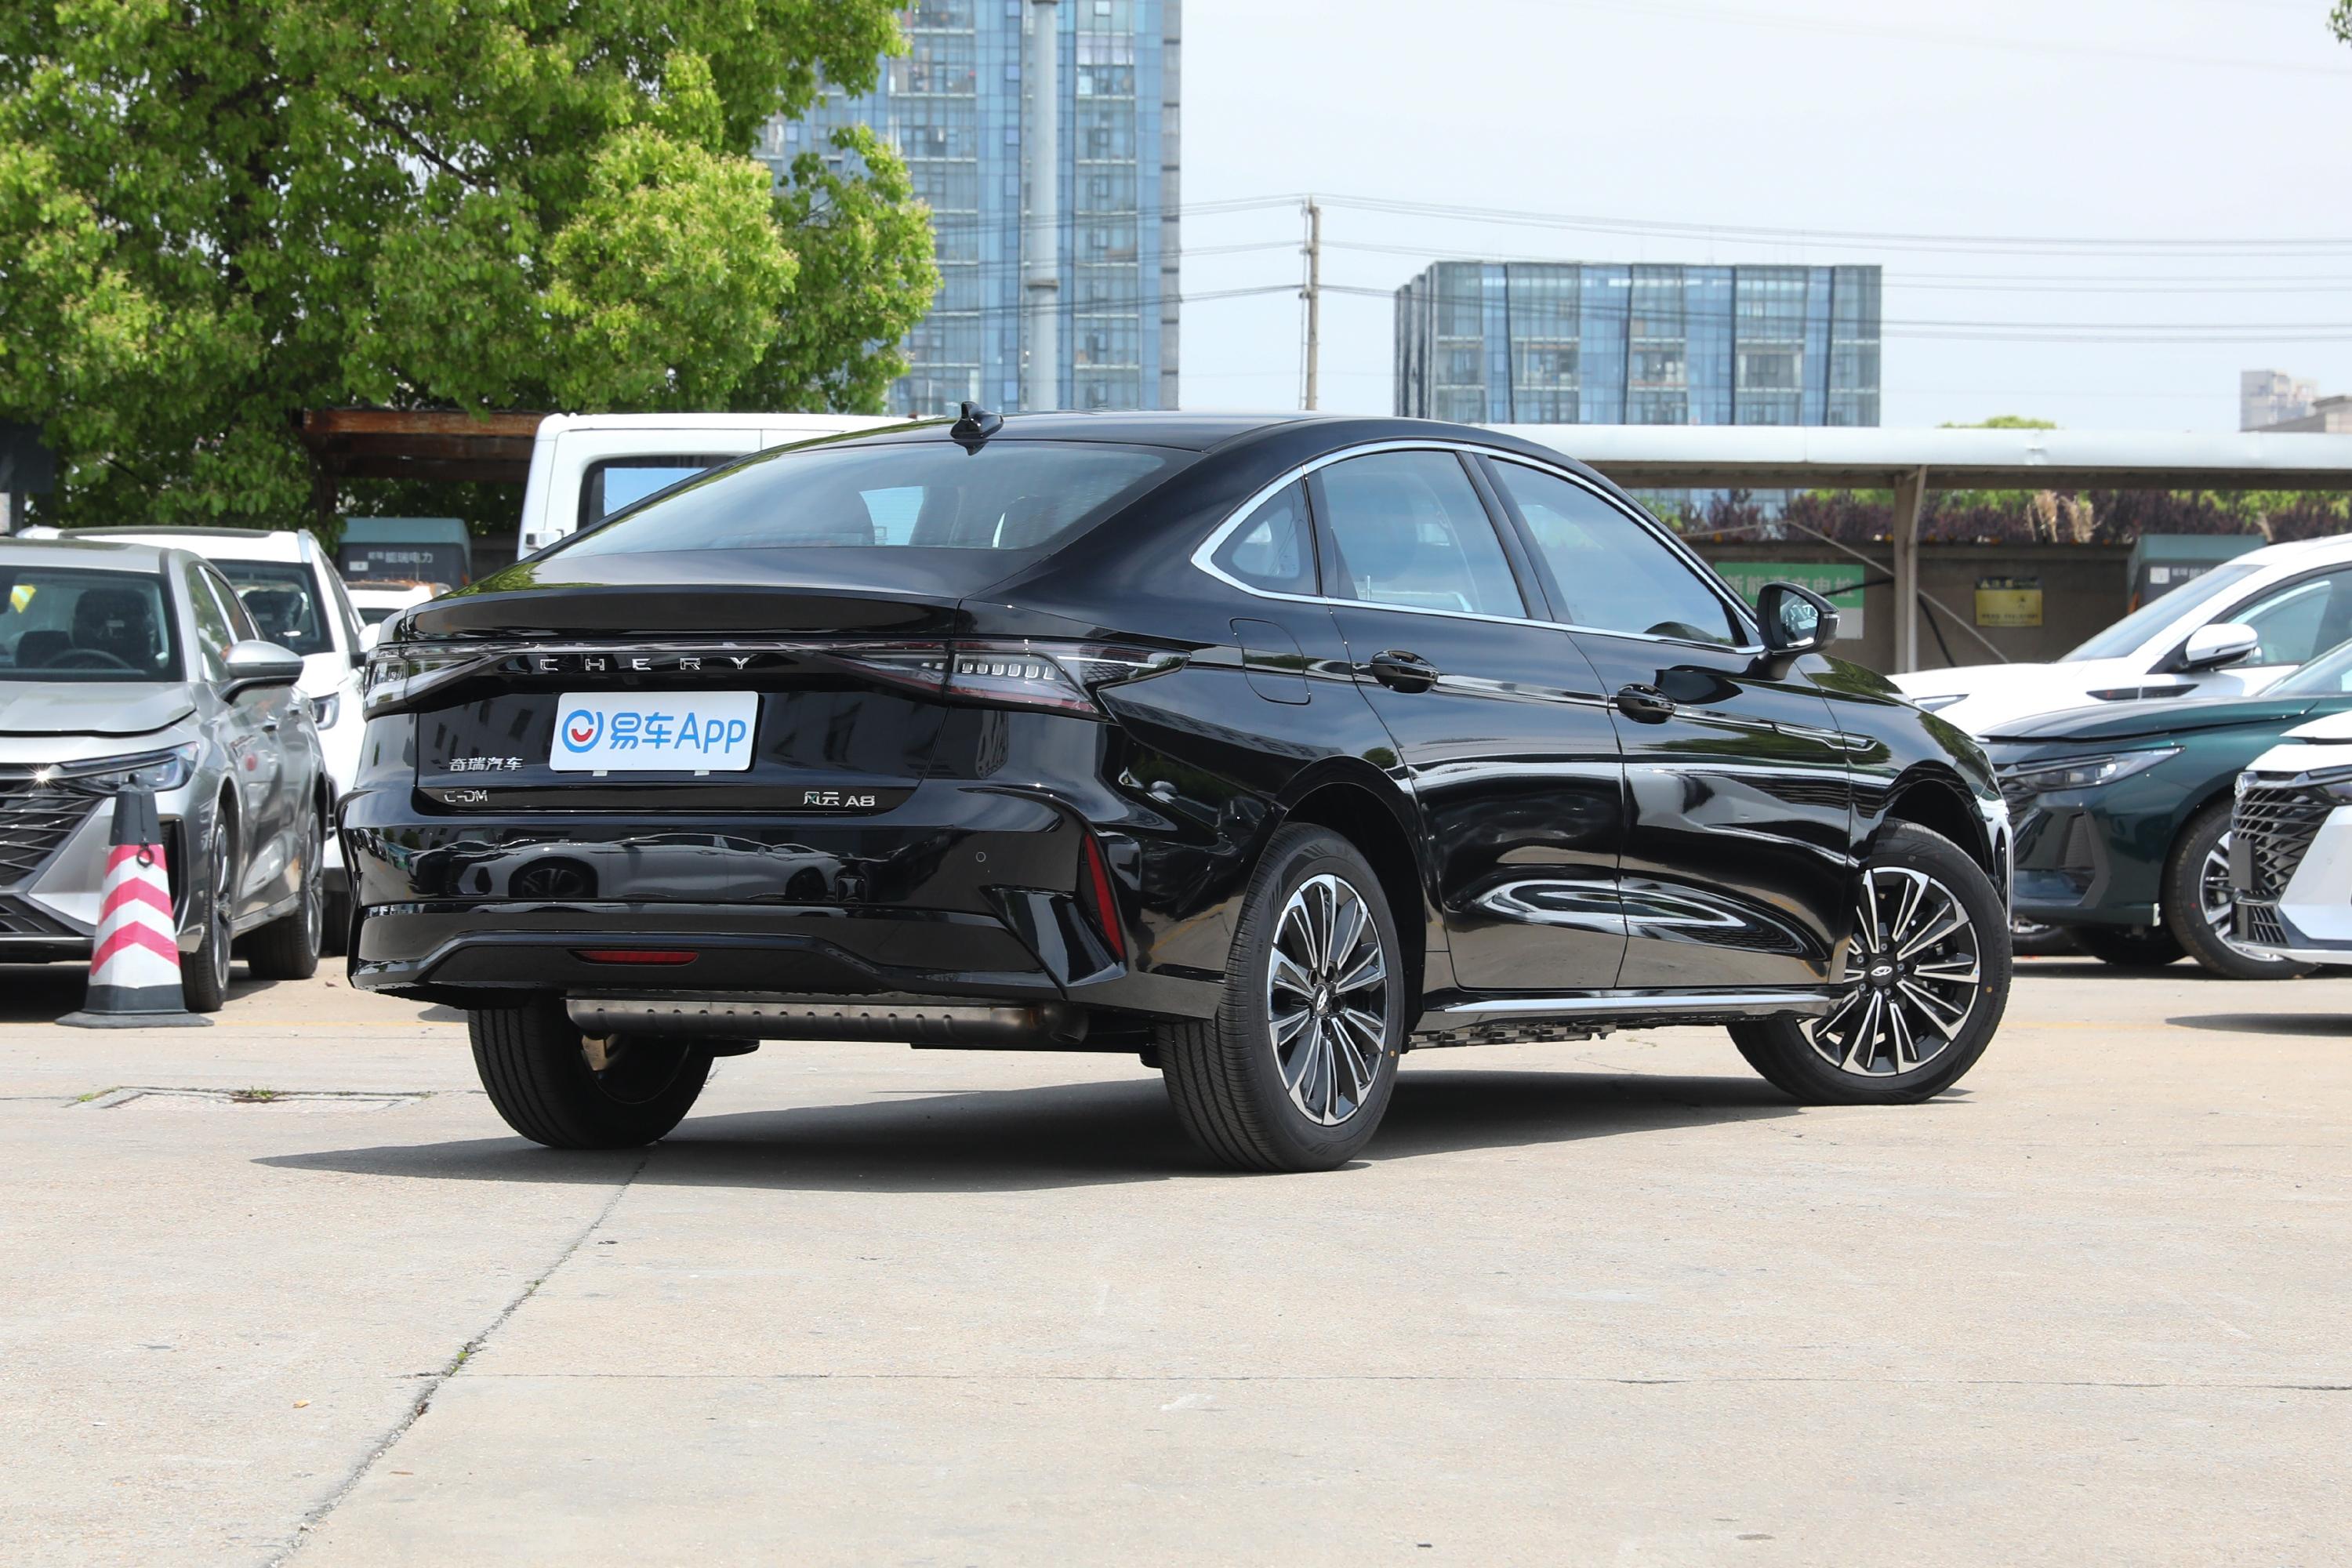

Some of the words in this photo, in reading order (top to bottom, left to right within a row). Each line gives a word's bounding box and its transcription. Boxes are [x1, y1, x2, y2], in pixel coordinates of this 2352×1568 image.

[539, 656, 750, 672] CHERY
[608, 711, 747, 754] 易车App
[448, 757, 524, 772] 奇瑞汽车
[444, 789, 488, 803] C-DM
[803, 791, 840, 806] 风云
[844, 795, 876, 808] A8
